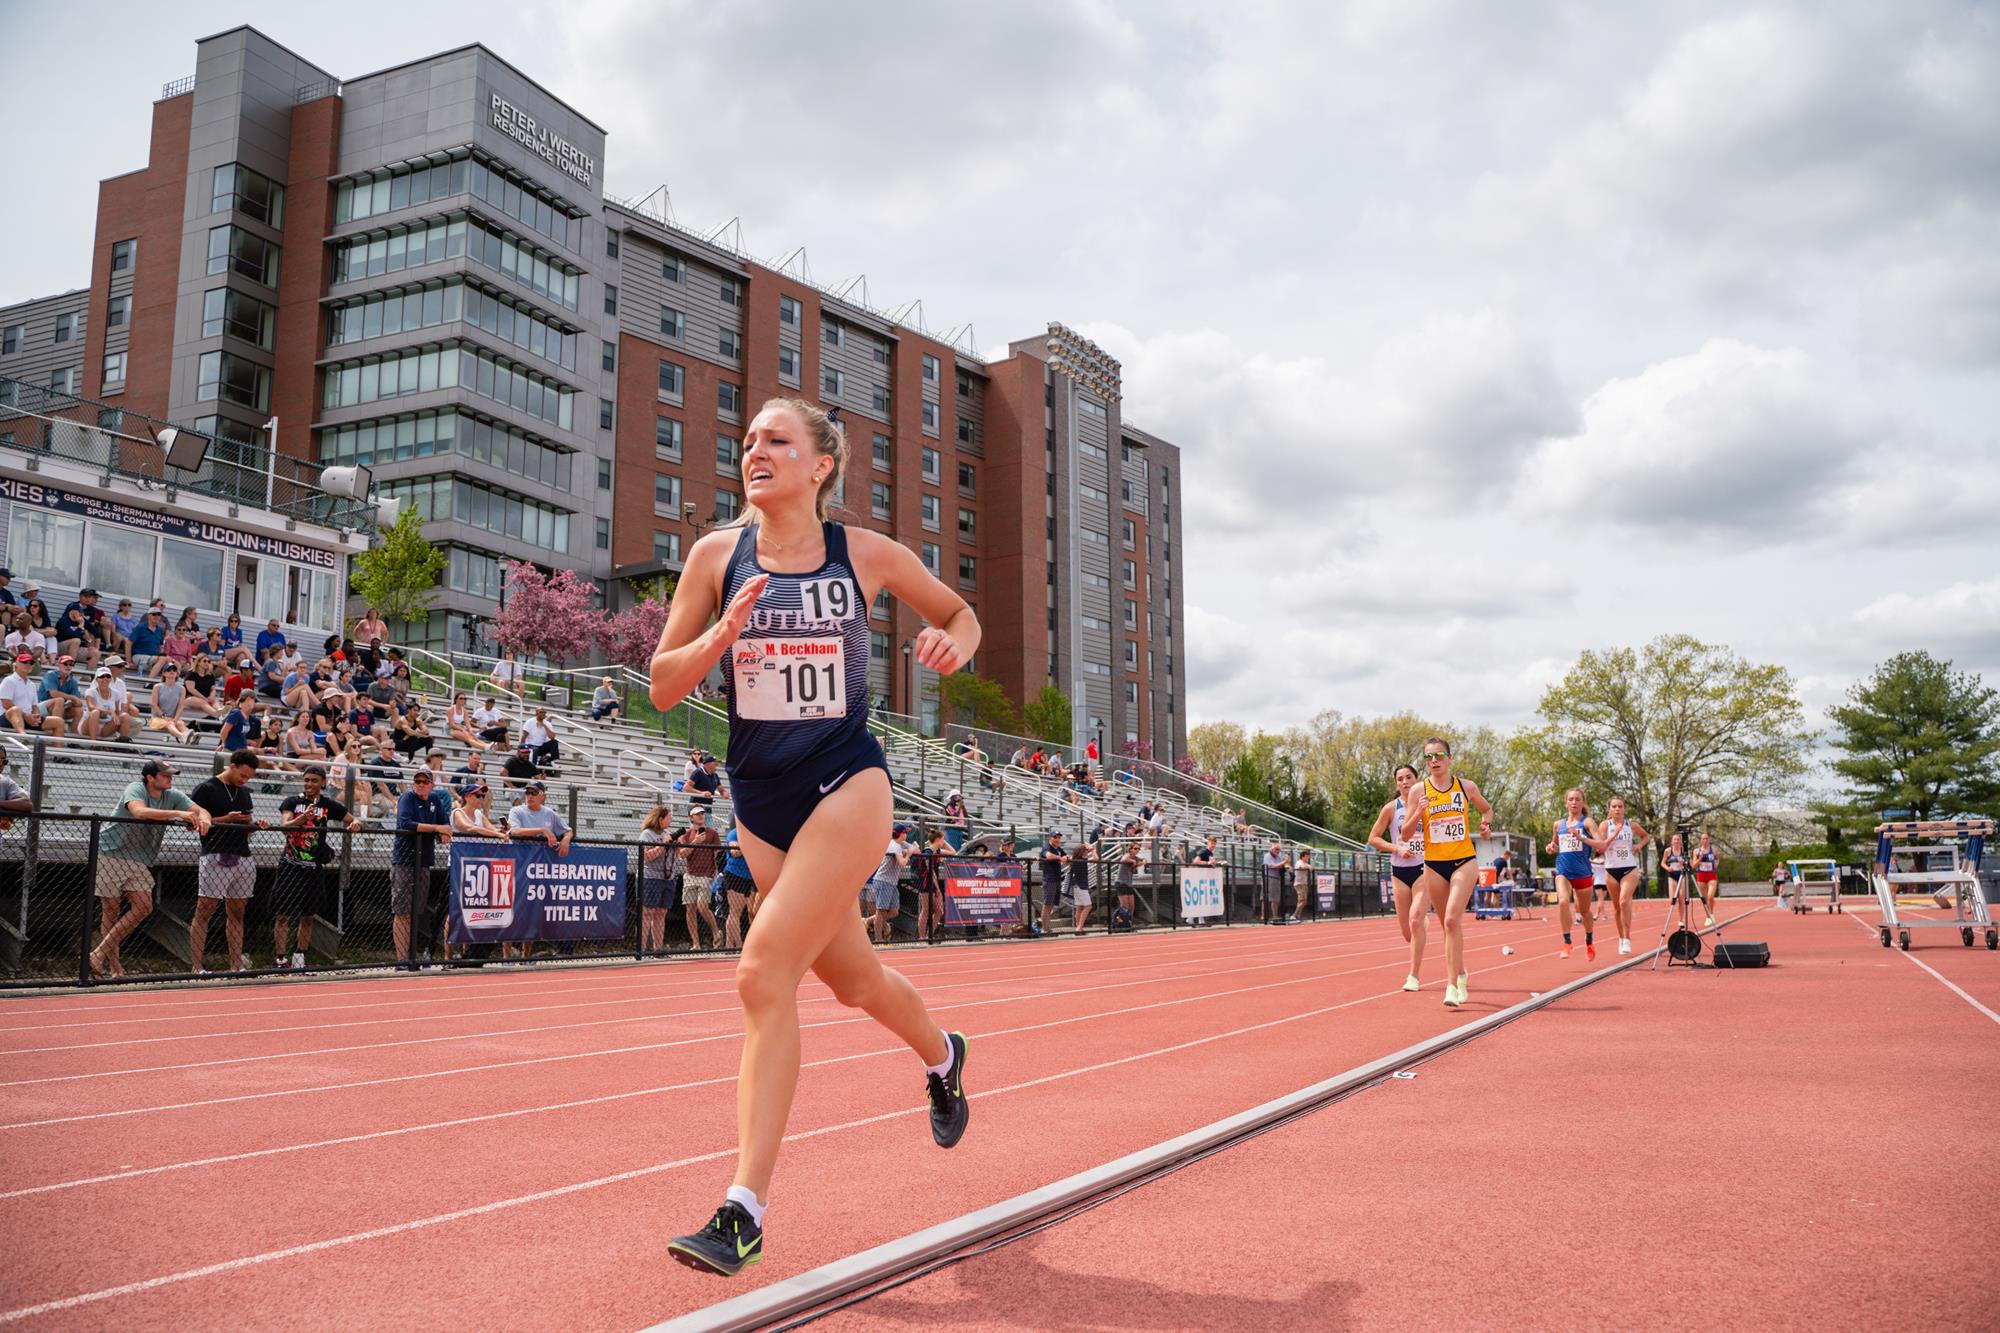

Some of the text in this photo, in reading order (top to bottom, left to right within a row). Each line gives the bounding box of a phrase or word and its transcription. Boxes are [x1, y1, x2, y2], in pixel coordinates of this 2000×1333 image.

[491, 93, 536, 135] PETER
[550, 132, 593, 173] WERTH
[494, 113, 590, 186] RESIDENCE TOWER
[63, 493, 186, 527] GEORGE J. SHERMAN FAMILY
[86, 507, 164, 530] SPORTS COMPLEX
[202, 524, 259, 550] UCONN
[267, 539, 335, 567] HUSKIES
[805, 580, 849, 619] 19
[765, 643, 838, 656] M. Beckham
[779, 663, 836, 703] 101
[1453, 793, 1463, 807] 4
[1445, 823, 1464, 837] 426
[464, 864, 489, 897] 50
[493, 865, 512, 873] TITLE
[526, 863, 617, 881] CELEBRATING
[464, 897, 489, 906] YEARS
[493, 874, 510, 906] IX
[527, 885, 615, 901] 50 YEARS OF
[1184, 879, 1208, 906] SoFi
[544, 906, 598, 922] TITLE IX
